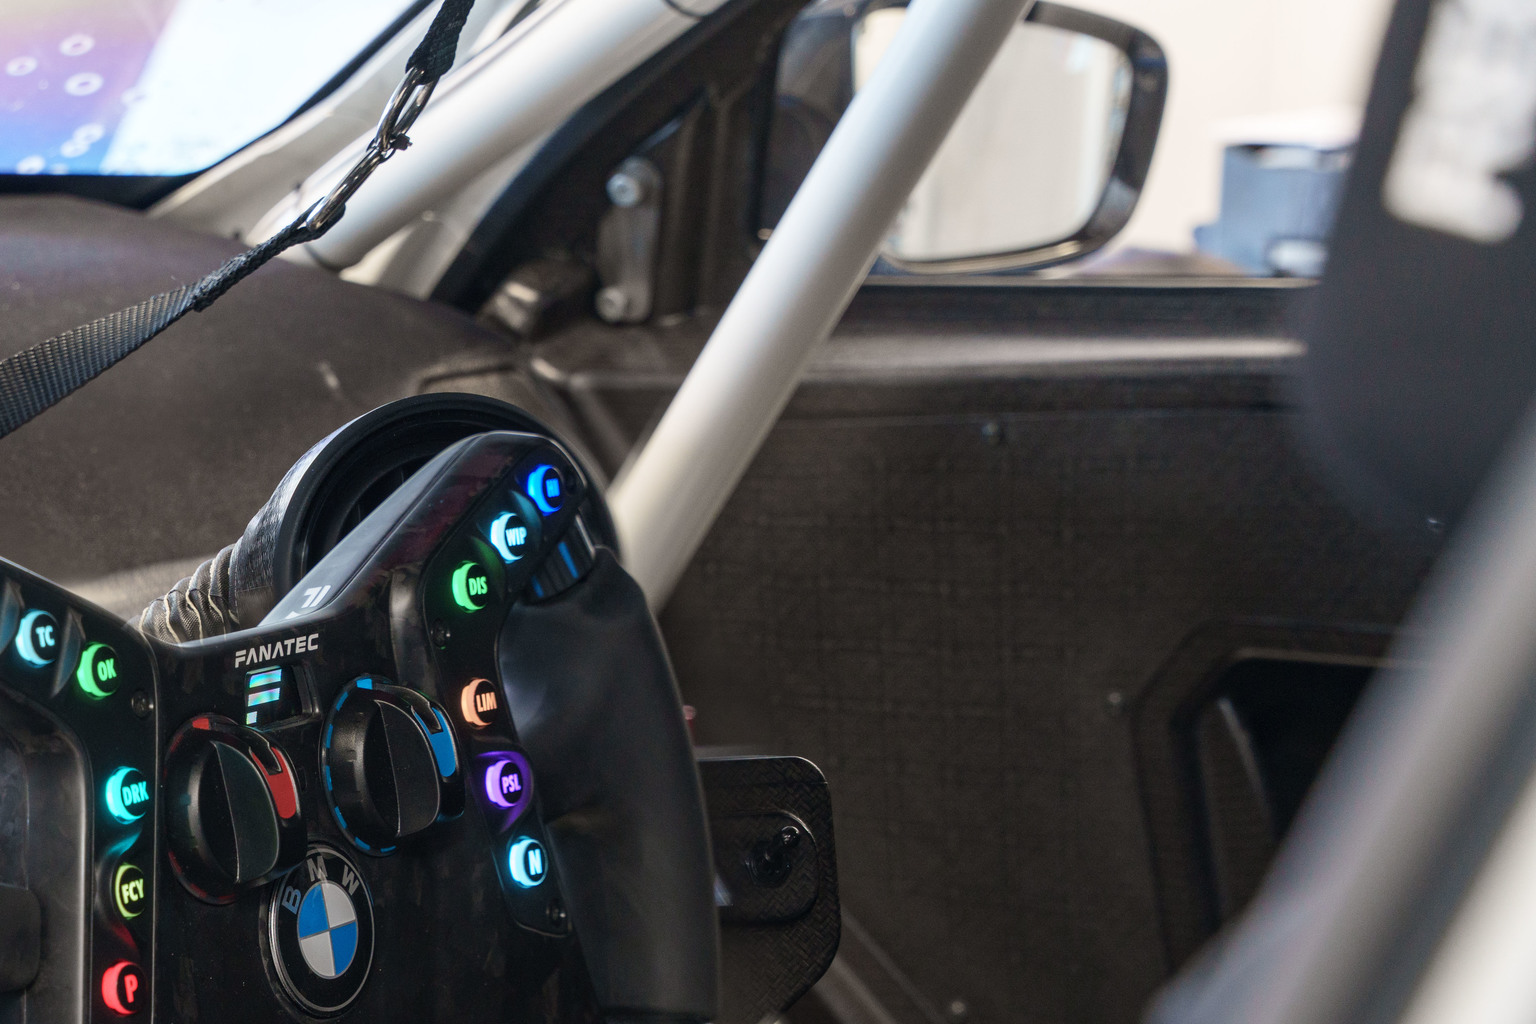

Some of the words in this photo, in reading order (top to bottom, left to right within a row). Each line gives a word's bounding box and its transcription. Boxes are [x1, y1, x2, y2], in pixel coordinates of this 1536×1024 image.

[506, 527, 527, 546] WIP
[469, 576, 488, 596] DIS
[36, 626, 55, 647] TC
[234, 633, 319, 668] FANATEC
[97, 659, 117, 681] OK
[476, 692, 497, 711] LIM
[121, 780, 150, 806] DRK
[501, 774, 521, 794] PSL
[529, 851, 541, 875] N
[121, 879, 144, 902] FCY
[281, 855, 360, 915] BMW
[124, 974, 138, 1002] P
